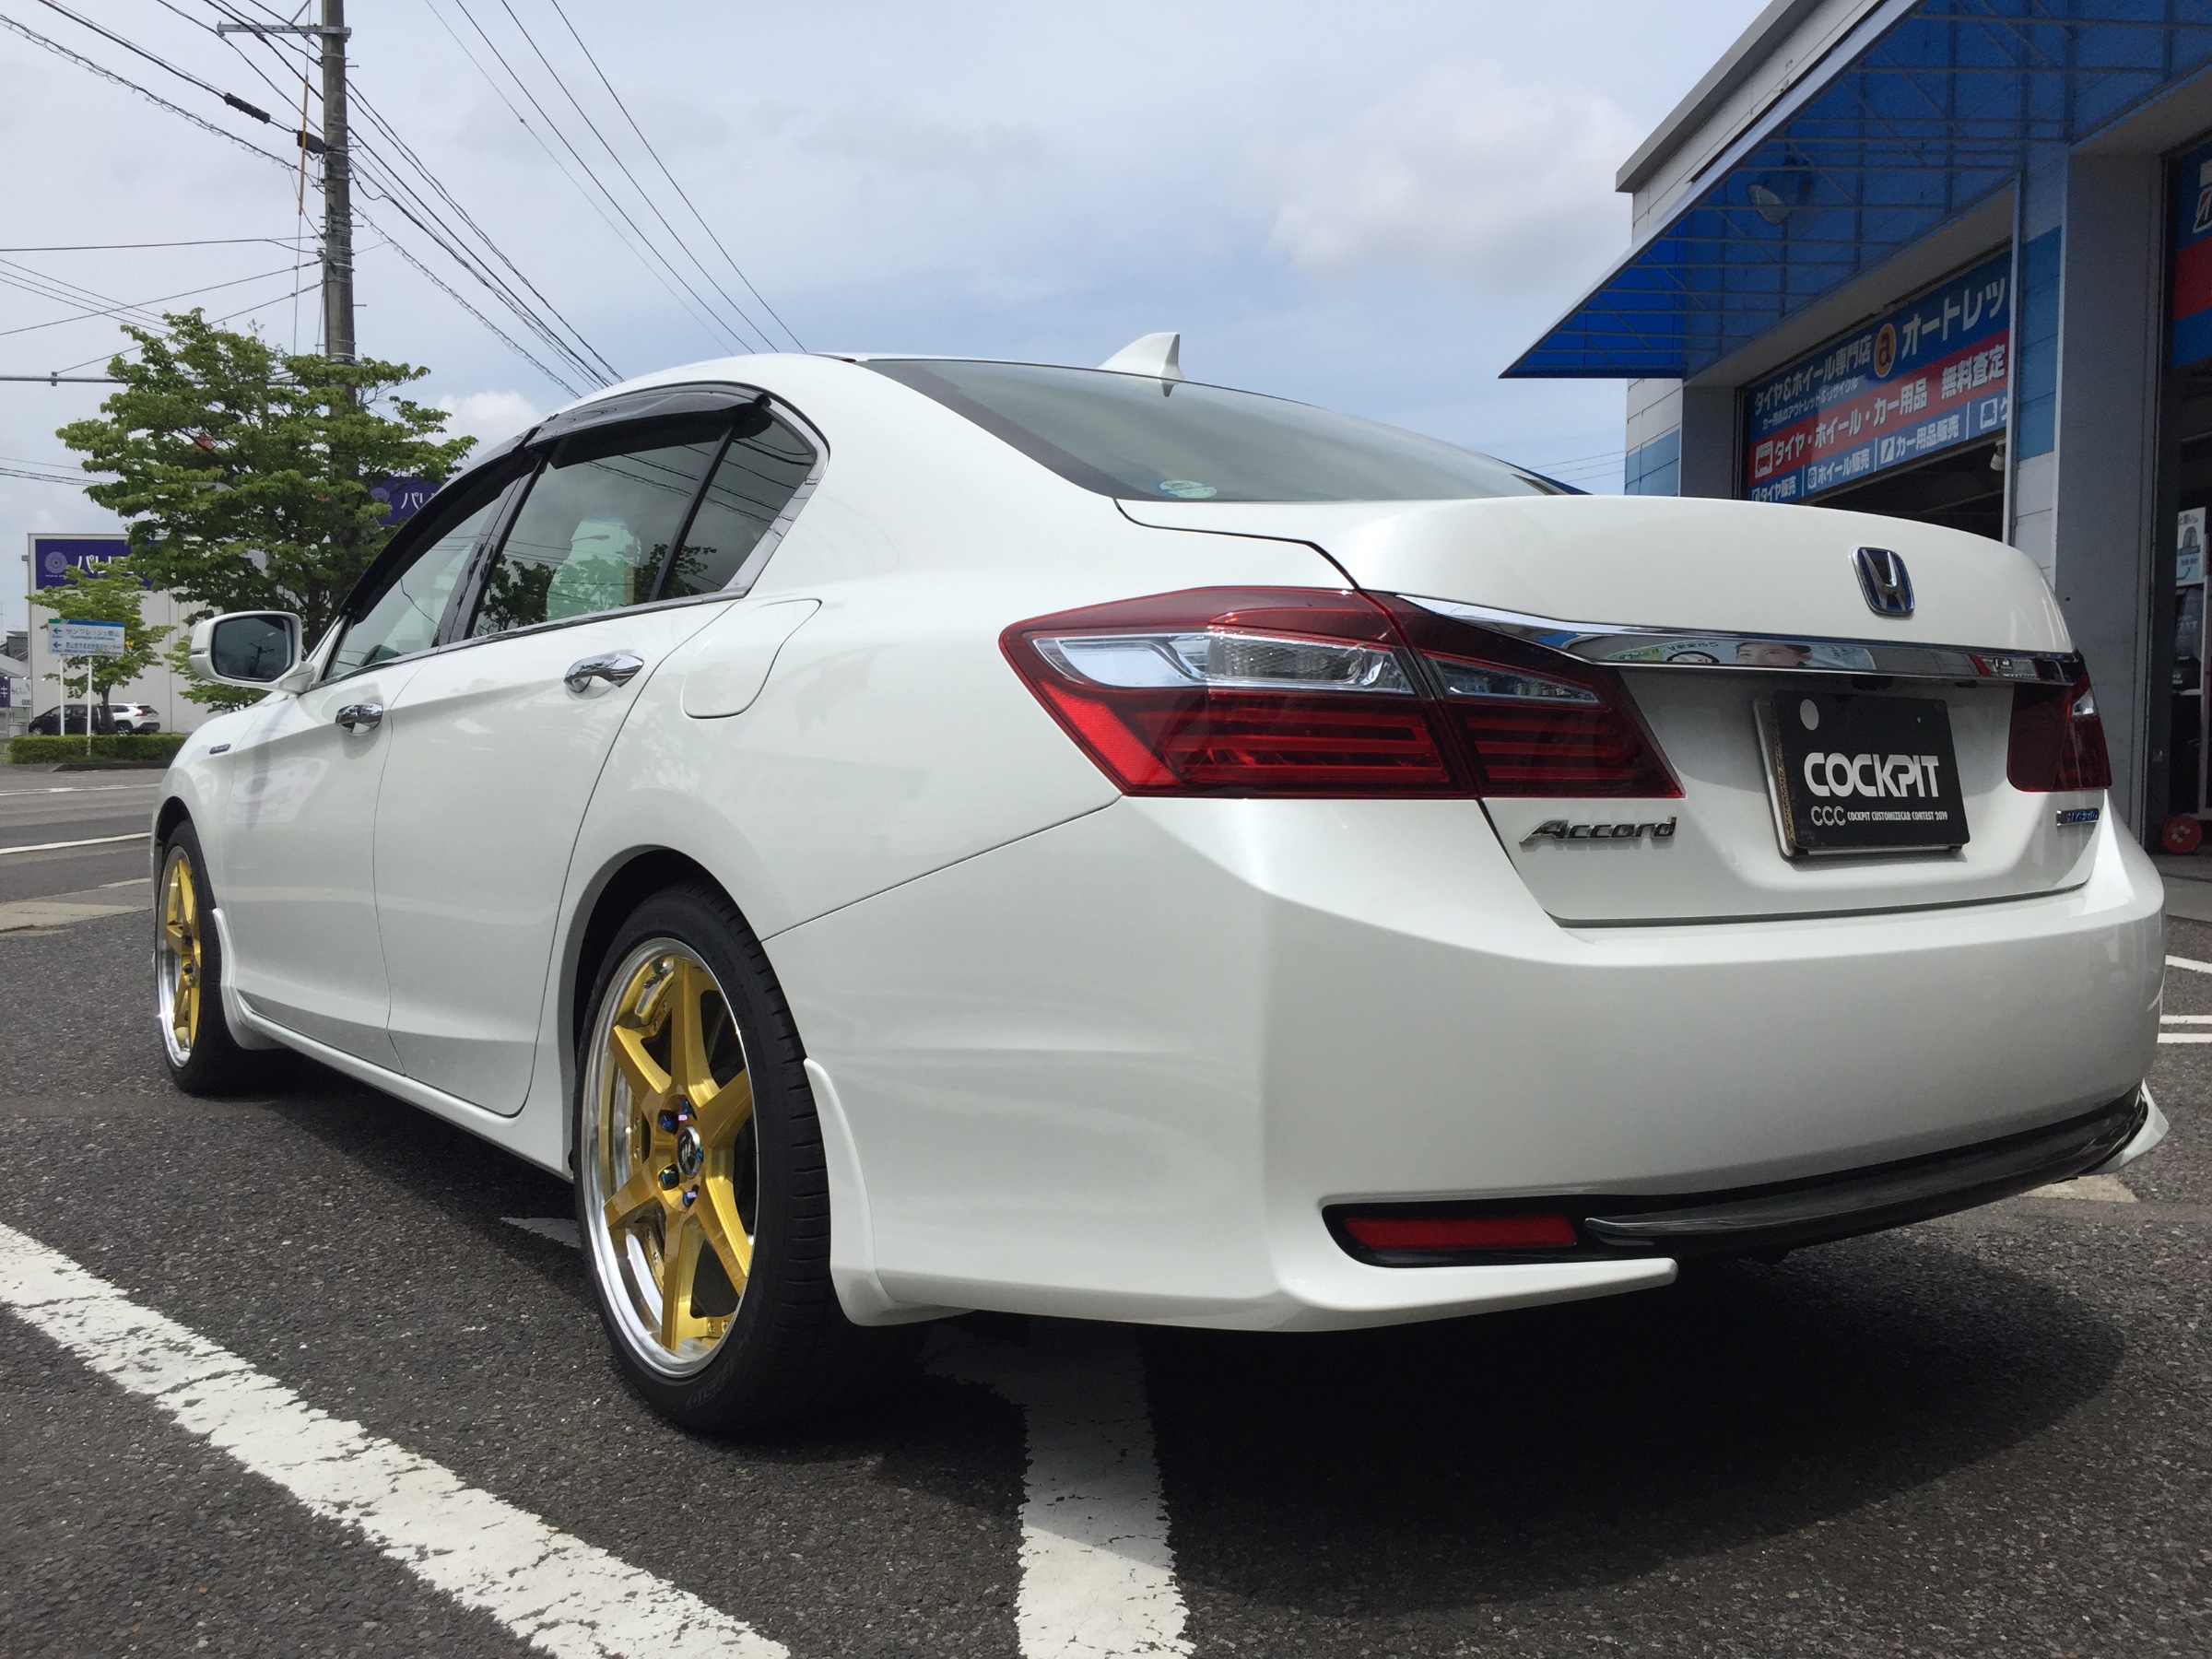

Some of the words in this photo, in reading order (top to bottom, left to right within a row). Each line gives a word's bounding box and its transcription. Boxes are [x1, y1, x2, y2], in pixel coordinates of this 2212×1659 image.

[1941, 344, 2006, 400] 無料査定
[1804, 751, 1940, 798] COCKPIT
[1519, 817, 1677, 843] Accord
[1810, 806, 1846, 826] CCC
[1847, 811, 1871, 821] COCKPIT
[1912, 811, 1935, 821] CONTEST
